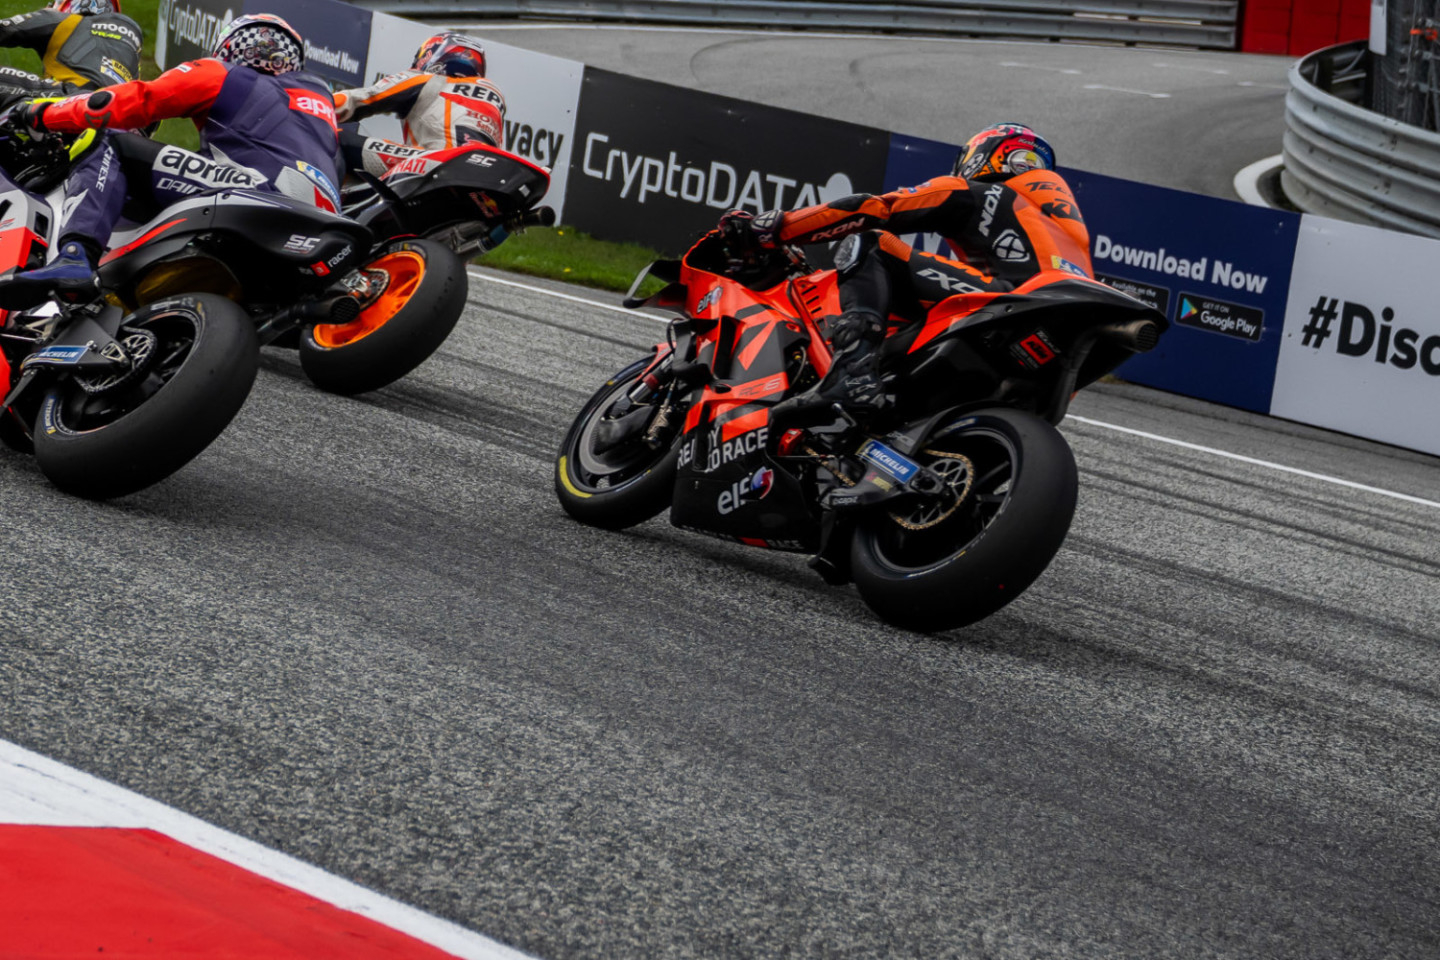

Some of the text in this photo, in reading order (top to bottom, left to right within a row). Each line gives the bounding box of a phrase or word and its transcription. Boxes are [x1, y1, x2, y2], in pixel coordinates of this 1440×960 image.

[339, 52, 360, 75] Now
[583, 132, 818, 213] CryptoDATA
[978, 184, 1004, 237] IXON
[286, 234, 321, 249] SC
[327, 244, 353, 268] racer
[1094, 235, 1268, 295] Download Now
[1200, 311, 1257, 337] Google Play
[723, 427, 768, 465] RACE
[872, 447, 910, 476] MICHELIN
